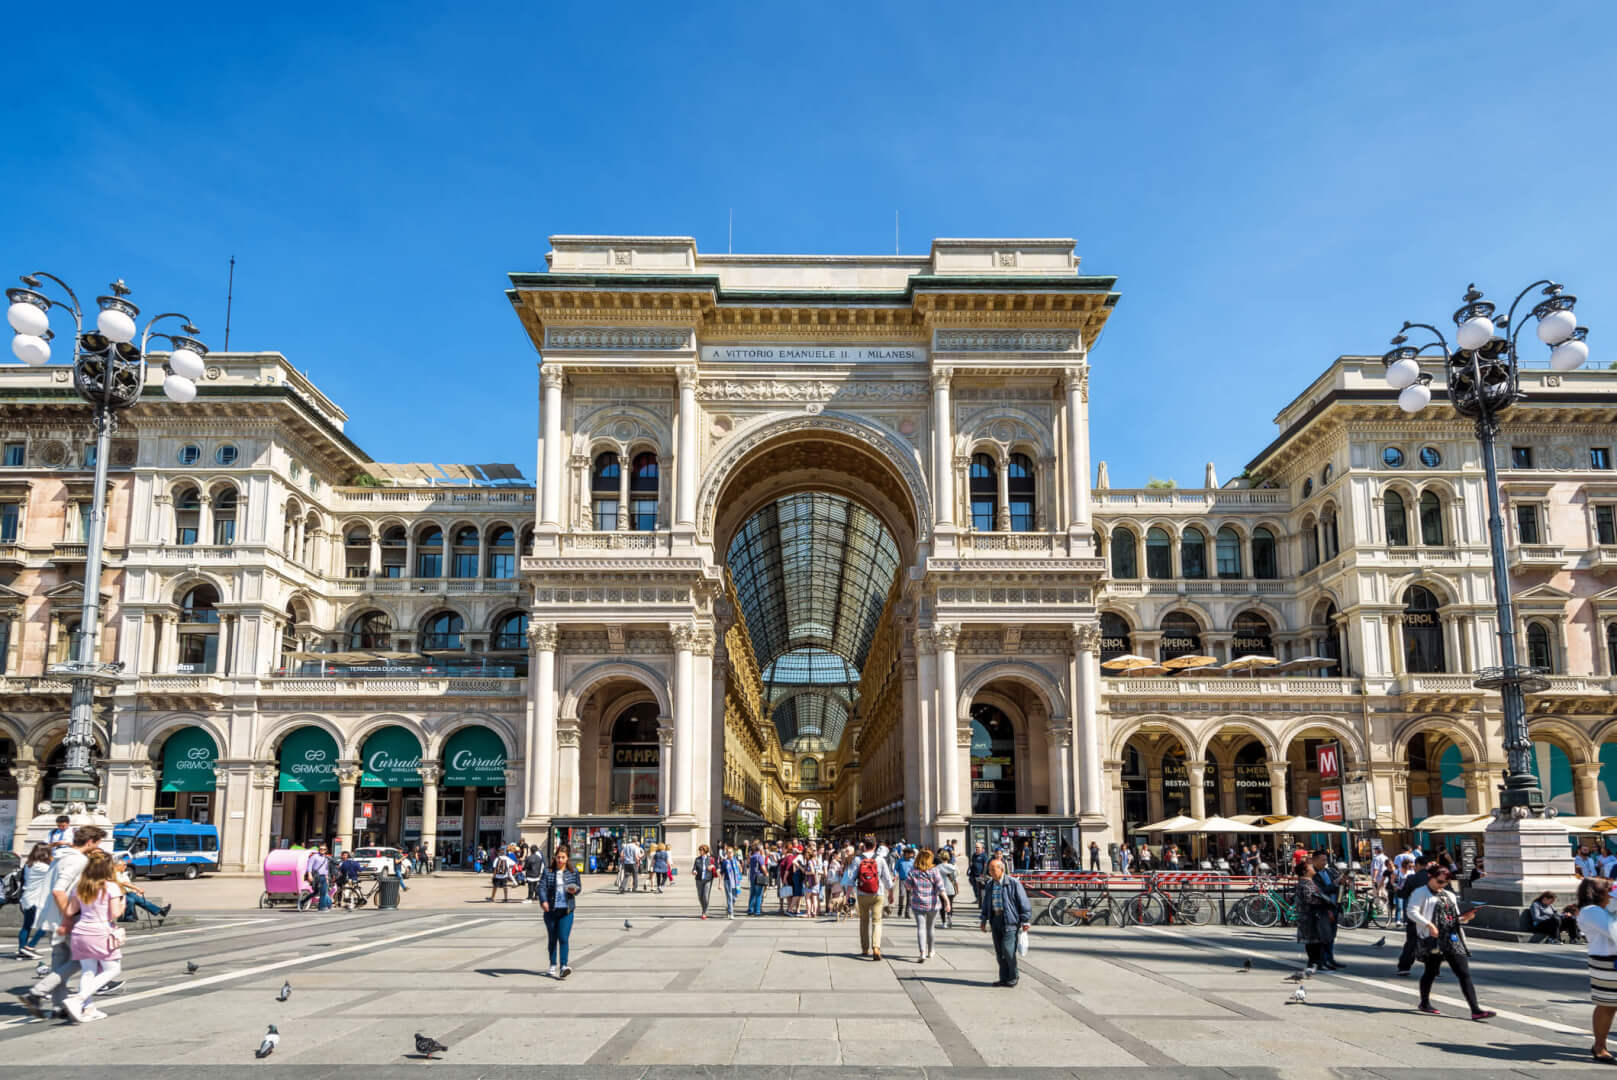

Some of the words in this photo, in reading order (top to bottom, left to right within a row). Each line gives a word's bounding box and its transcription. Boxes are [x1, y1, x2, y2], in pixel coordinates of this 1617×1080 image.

[726, 351, 774, 359] VITTORIO
[779, 351, 836, 359] EMANUELE
[867, 351, 914, 359] MILANESI
[1101, 638, 1125, 648] EROL
[1160, 637, 1195, 648] APEROL
[369, 750, 422, 772] Currado
[452, 750, 505, 771] Currado
[1320, 751, 1337, 773] M
